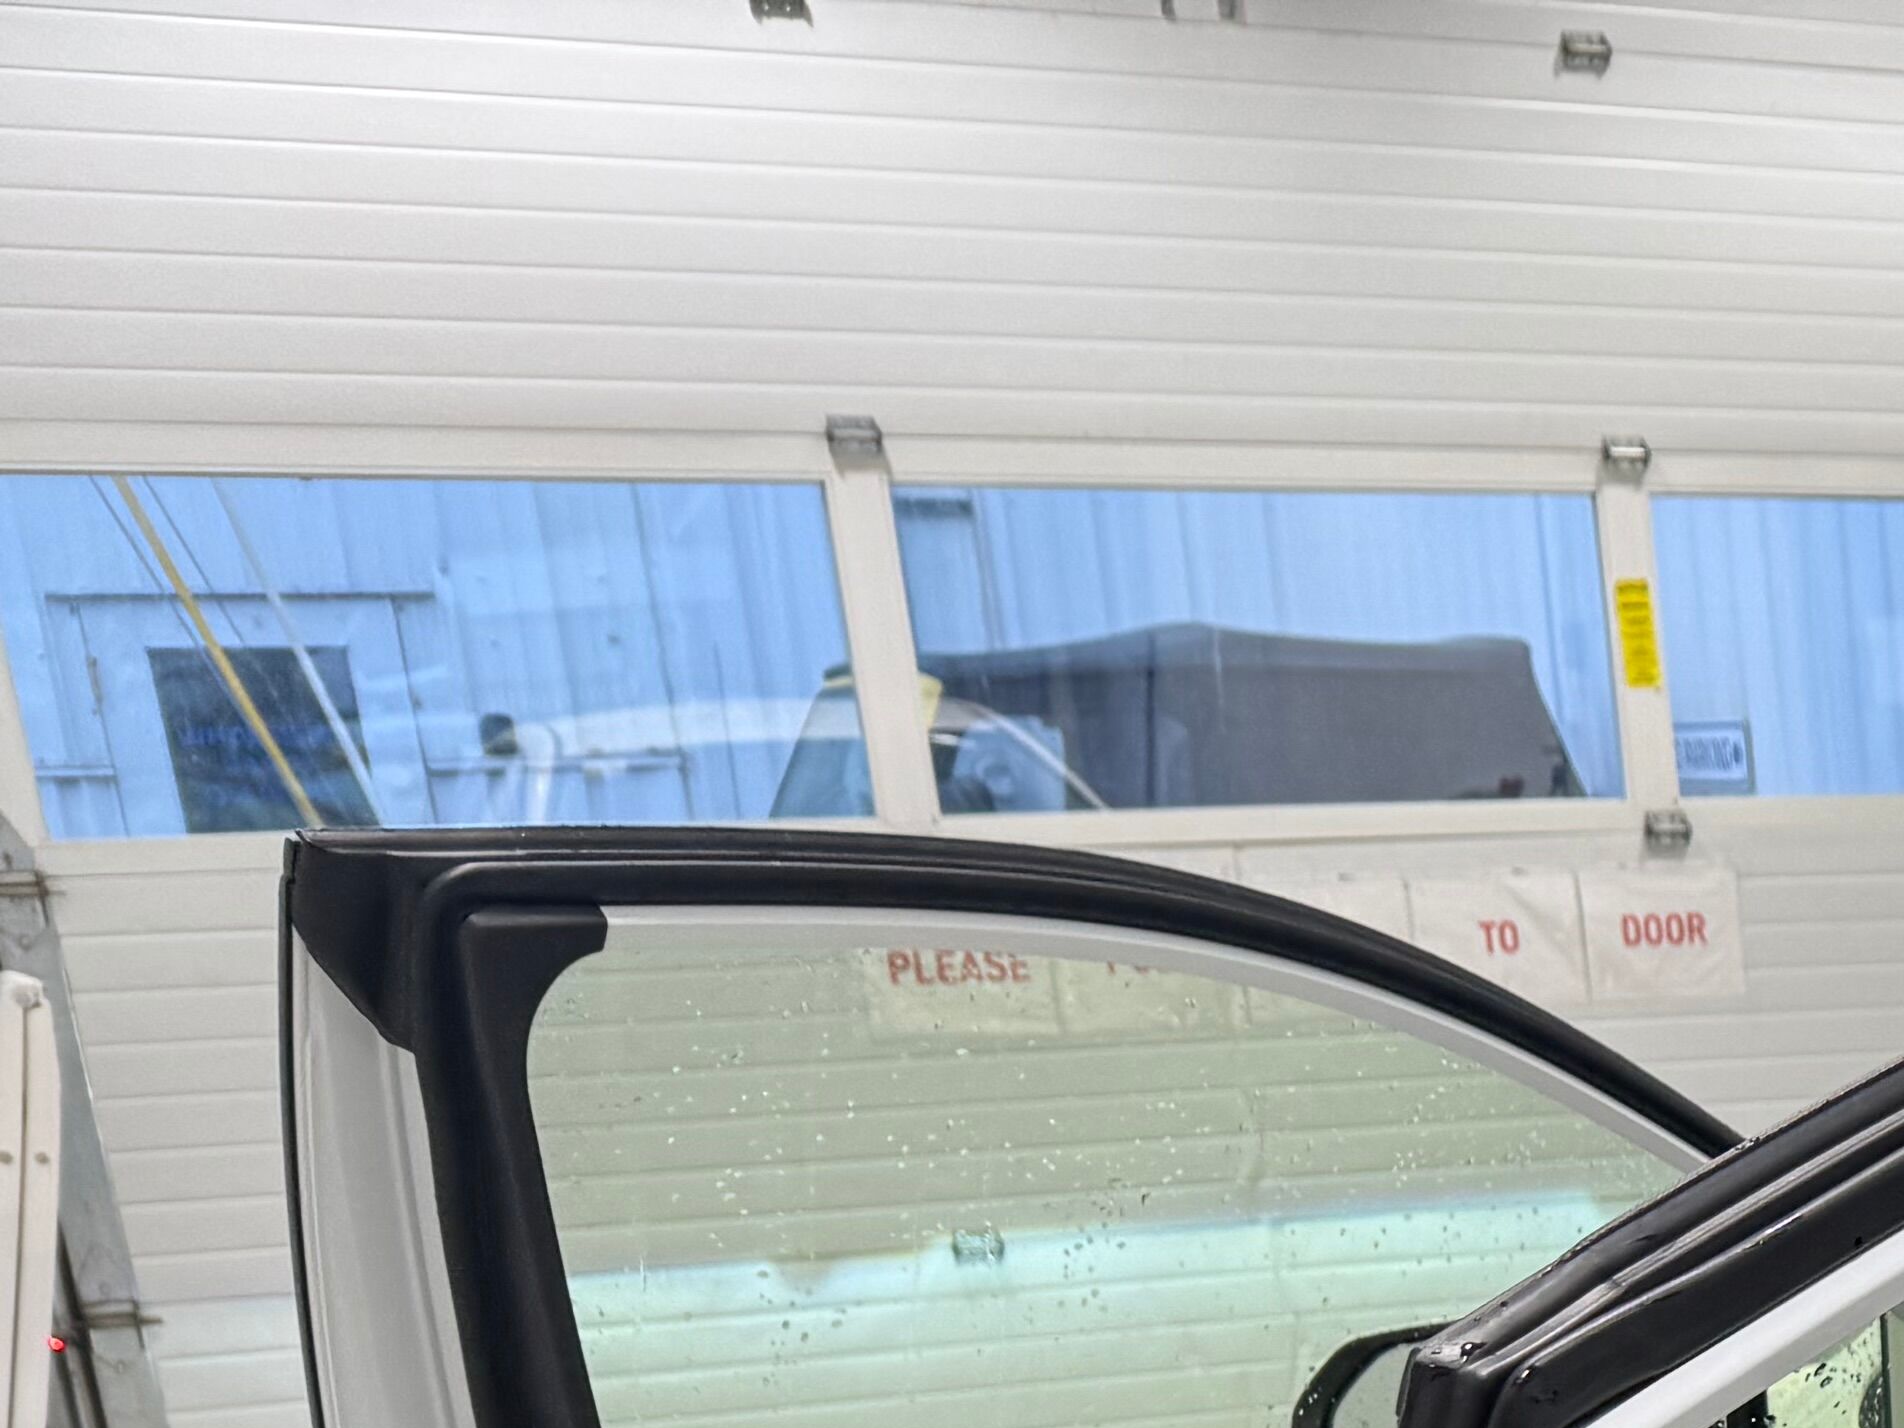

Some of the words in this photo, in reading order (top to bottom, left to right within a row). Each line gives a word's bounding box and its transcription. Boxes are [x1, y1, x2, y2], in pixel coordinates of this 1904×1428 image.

[886, 948, 1032, 986] PLEASE
[1477, 918, 1521, 957] TO
[1620, 910, 1709, 949] DOOR
